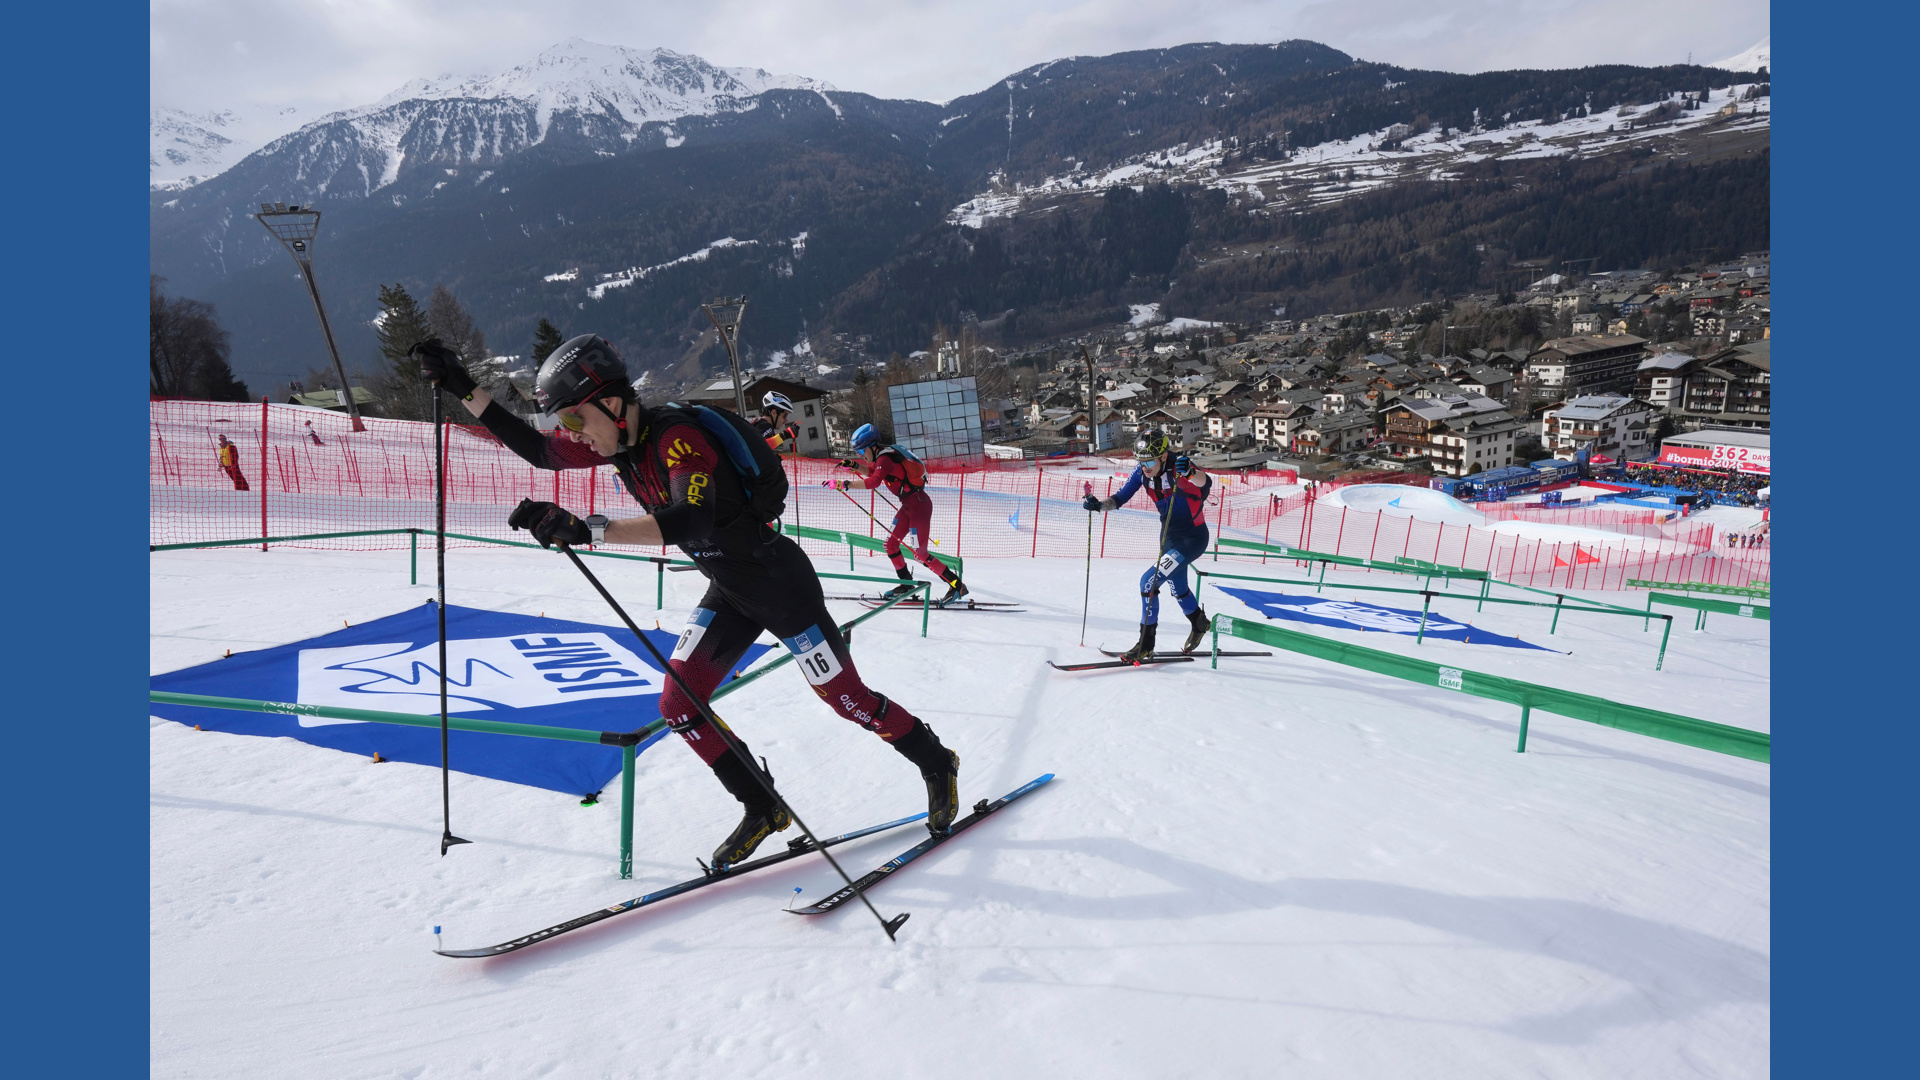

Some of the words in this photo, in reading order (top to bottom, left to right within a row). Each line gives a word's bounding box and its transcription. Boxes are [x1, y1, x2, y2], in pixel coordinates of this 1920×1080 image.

[546, 346, 582, 378] SWISSPEAK
[1666, 452, 1744, 470] #bormio2026
[1714, 446, 1749, 461] 362
[1752, 454, 1770, 462] DAYS
[1160, 557, 1173, 570] 20
[510, 637, 652, 694] ISMF
[804, 651, 830, 678] 16
[1440, 678, 1461, 688] ISMF
[729, 849, 744, 861] LA
